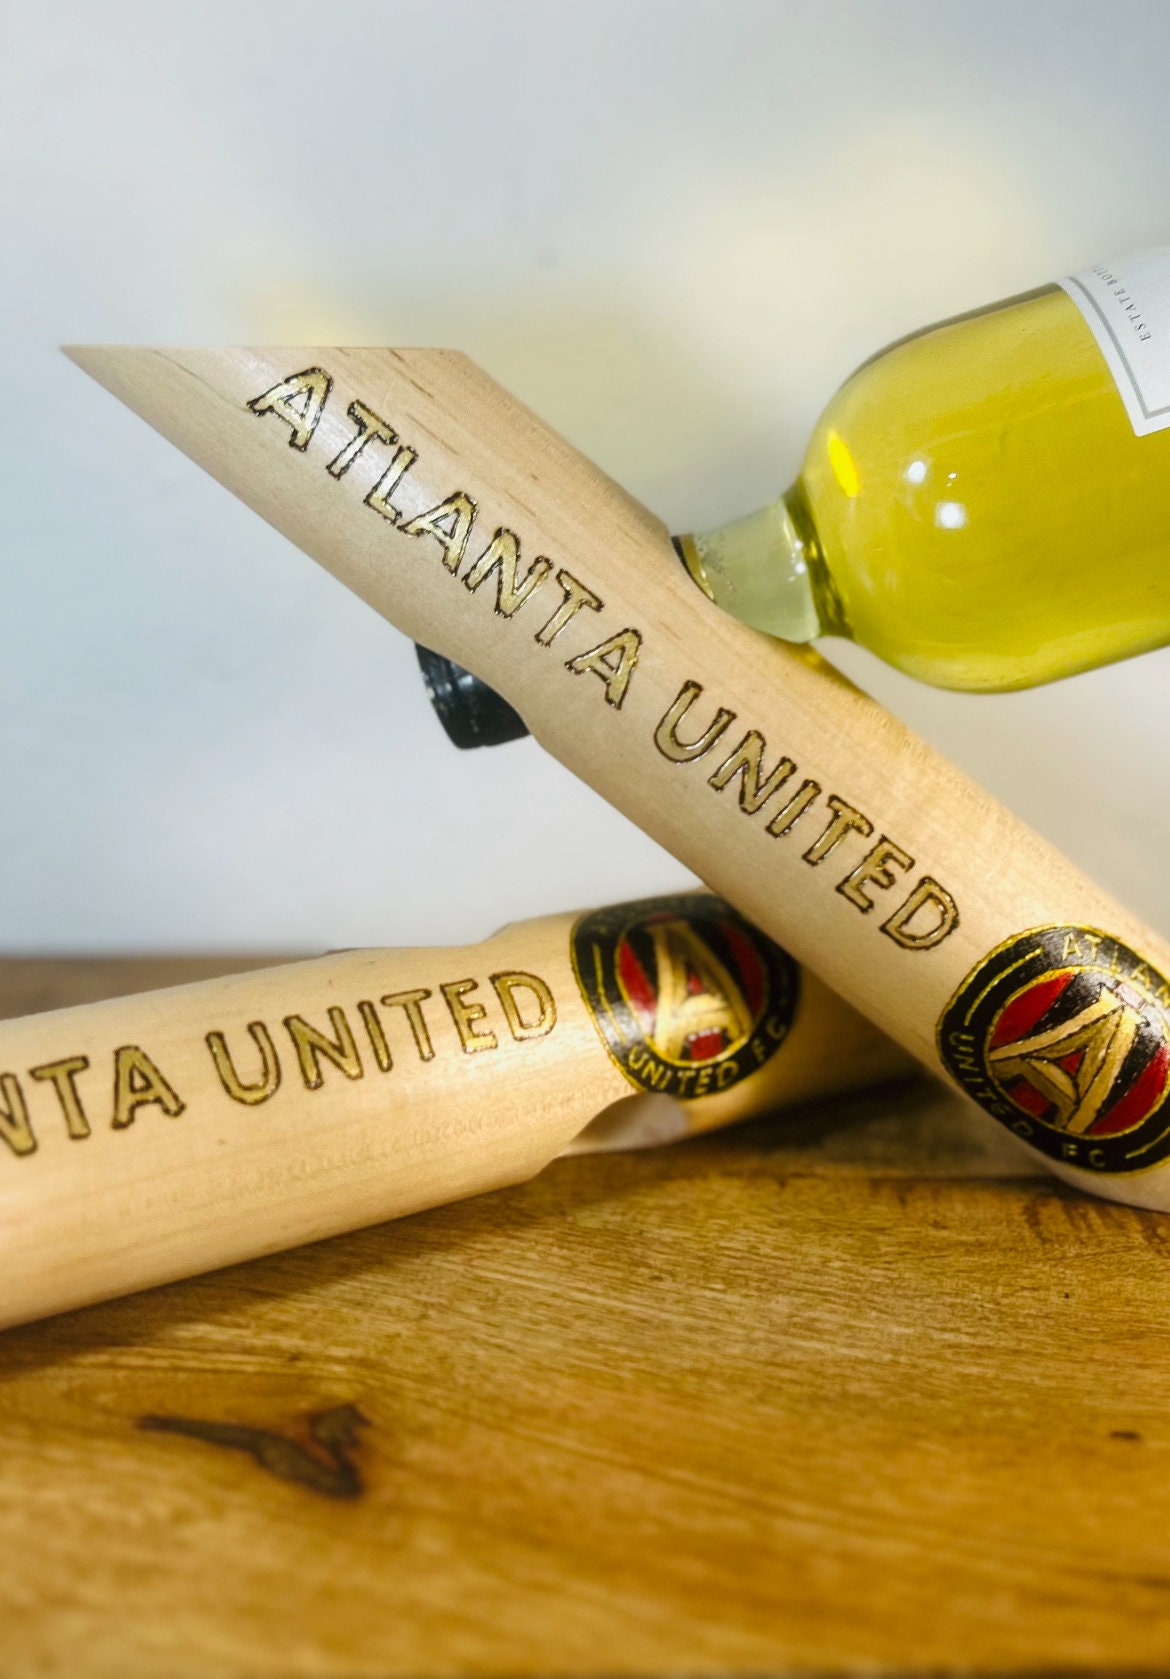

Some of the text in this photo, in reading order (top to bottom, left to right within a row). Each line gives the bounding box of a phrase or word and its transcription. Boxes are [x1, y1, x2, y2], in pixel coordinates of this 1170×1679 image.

[1114, 289, 1151, 341] ESTATE
[247, 366, 961, 952] ATLANTA UNITED
[205, 970, 558, 1106] UNITED
[627, 1015, 786, 1095] UNITED FC
[950, 1032, 1033, 1136] UNITED
